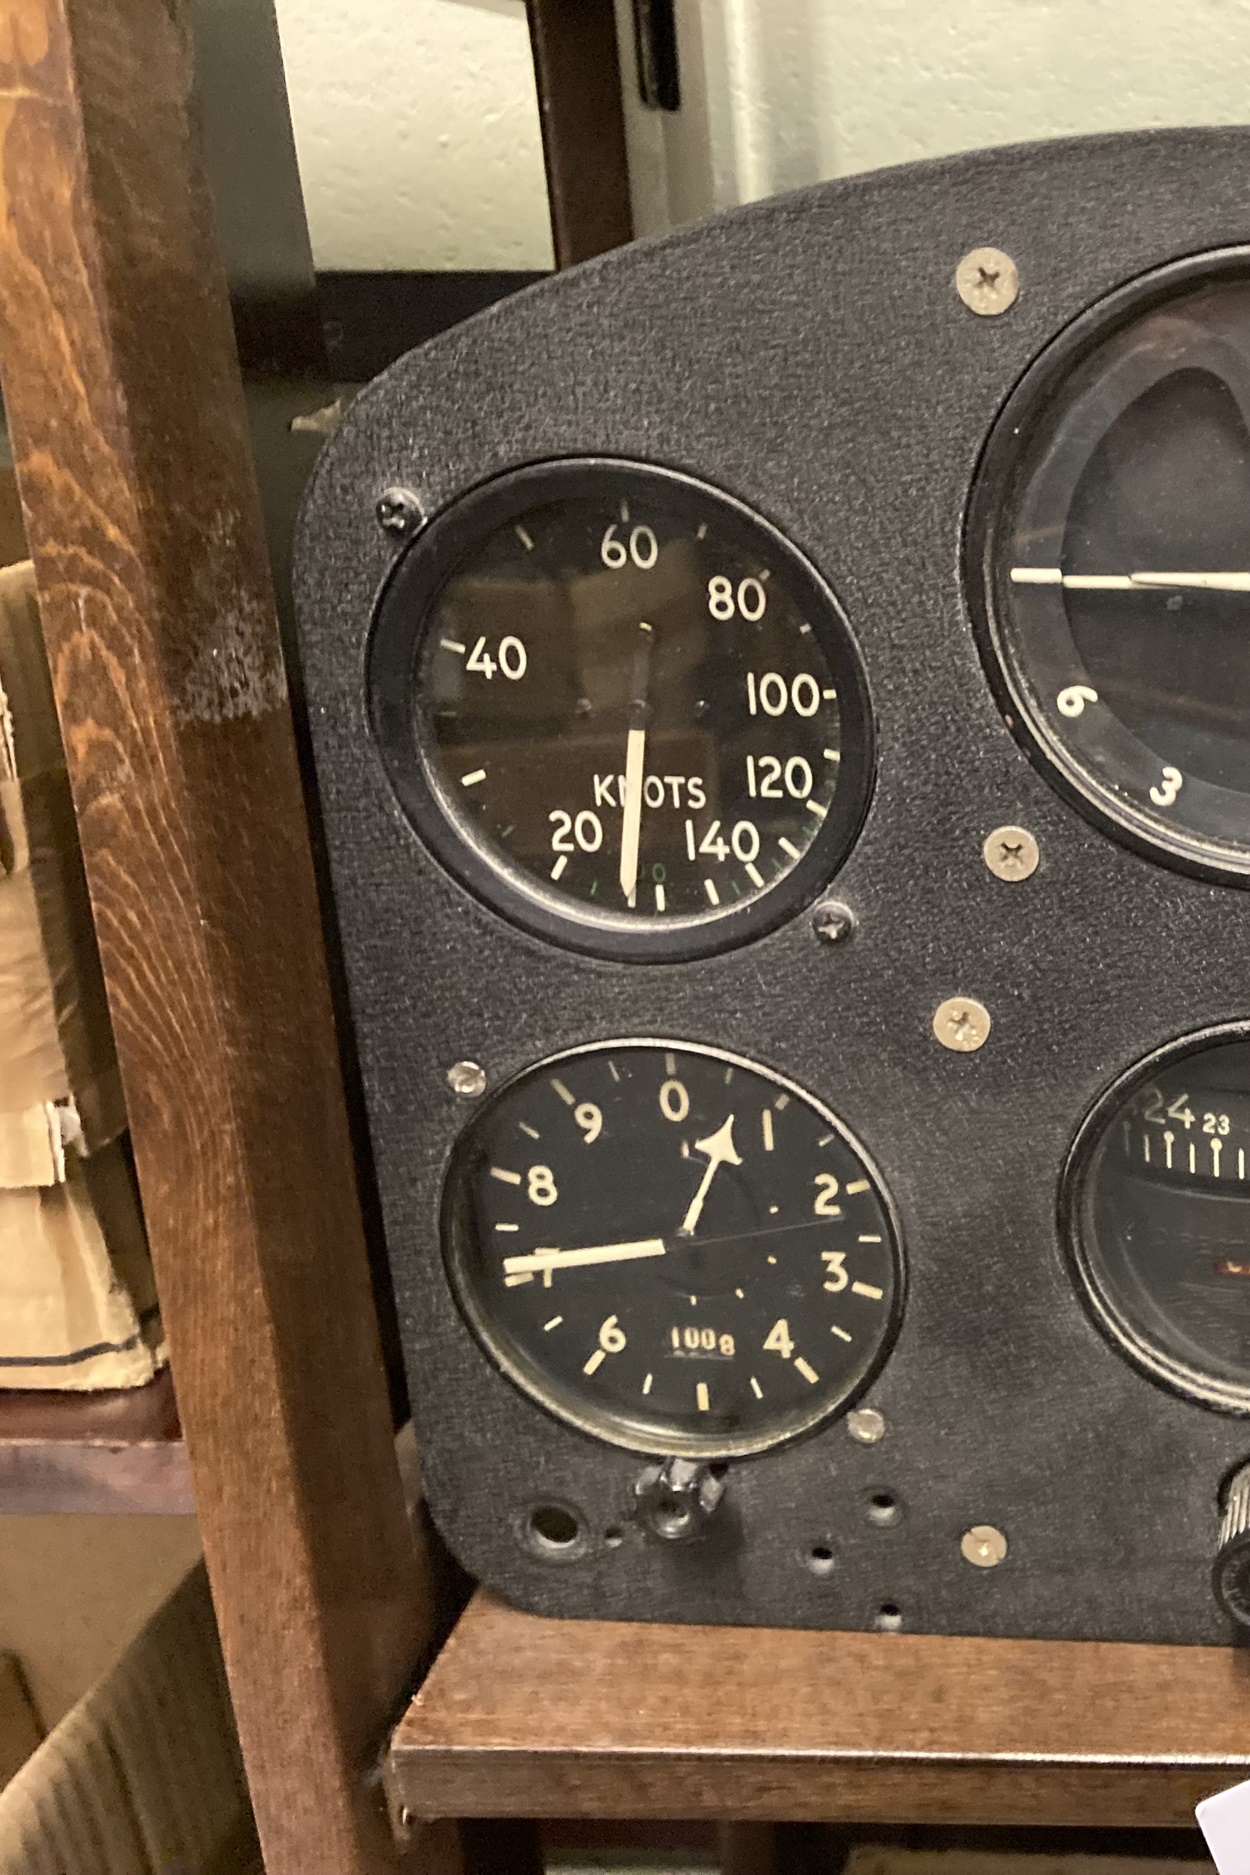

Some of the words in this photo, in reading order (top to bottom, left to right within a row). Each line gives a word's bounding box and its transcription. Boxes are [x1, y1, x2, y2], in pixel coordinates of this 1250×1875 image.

[601, 524, 658, 569] 60
[708, 576, 766, 621] 80
[466, 636, 527, 680] 40
[747, 672, 820, 717] 100
[746, 755, 813, 799] 120
[1150, 766, 1182, 806] 3
[549, 810, 603, 852] 20
[685, 819, 760, 863] 140
[659, 1079, 689, 1122] 0
[1144, 1088, 1196, 1129] 24
[1202, 1112, 1230, 1136] 23
[574, 1102, 602, 1143] 9
[762, 1109, 774, 1151] 1
[527, 1165, 559, 1207] 8
[814, 1174, 841, 1216] 2
[821, 1251, 849, 1292] 3
[599, 1315, 627, 1354] 6
[763, 1319, 795, 1359] 4
